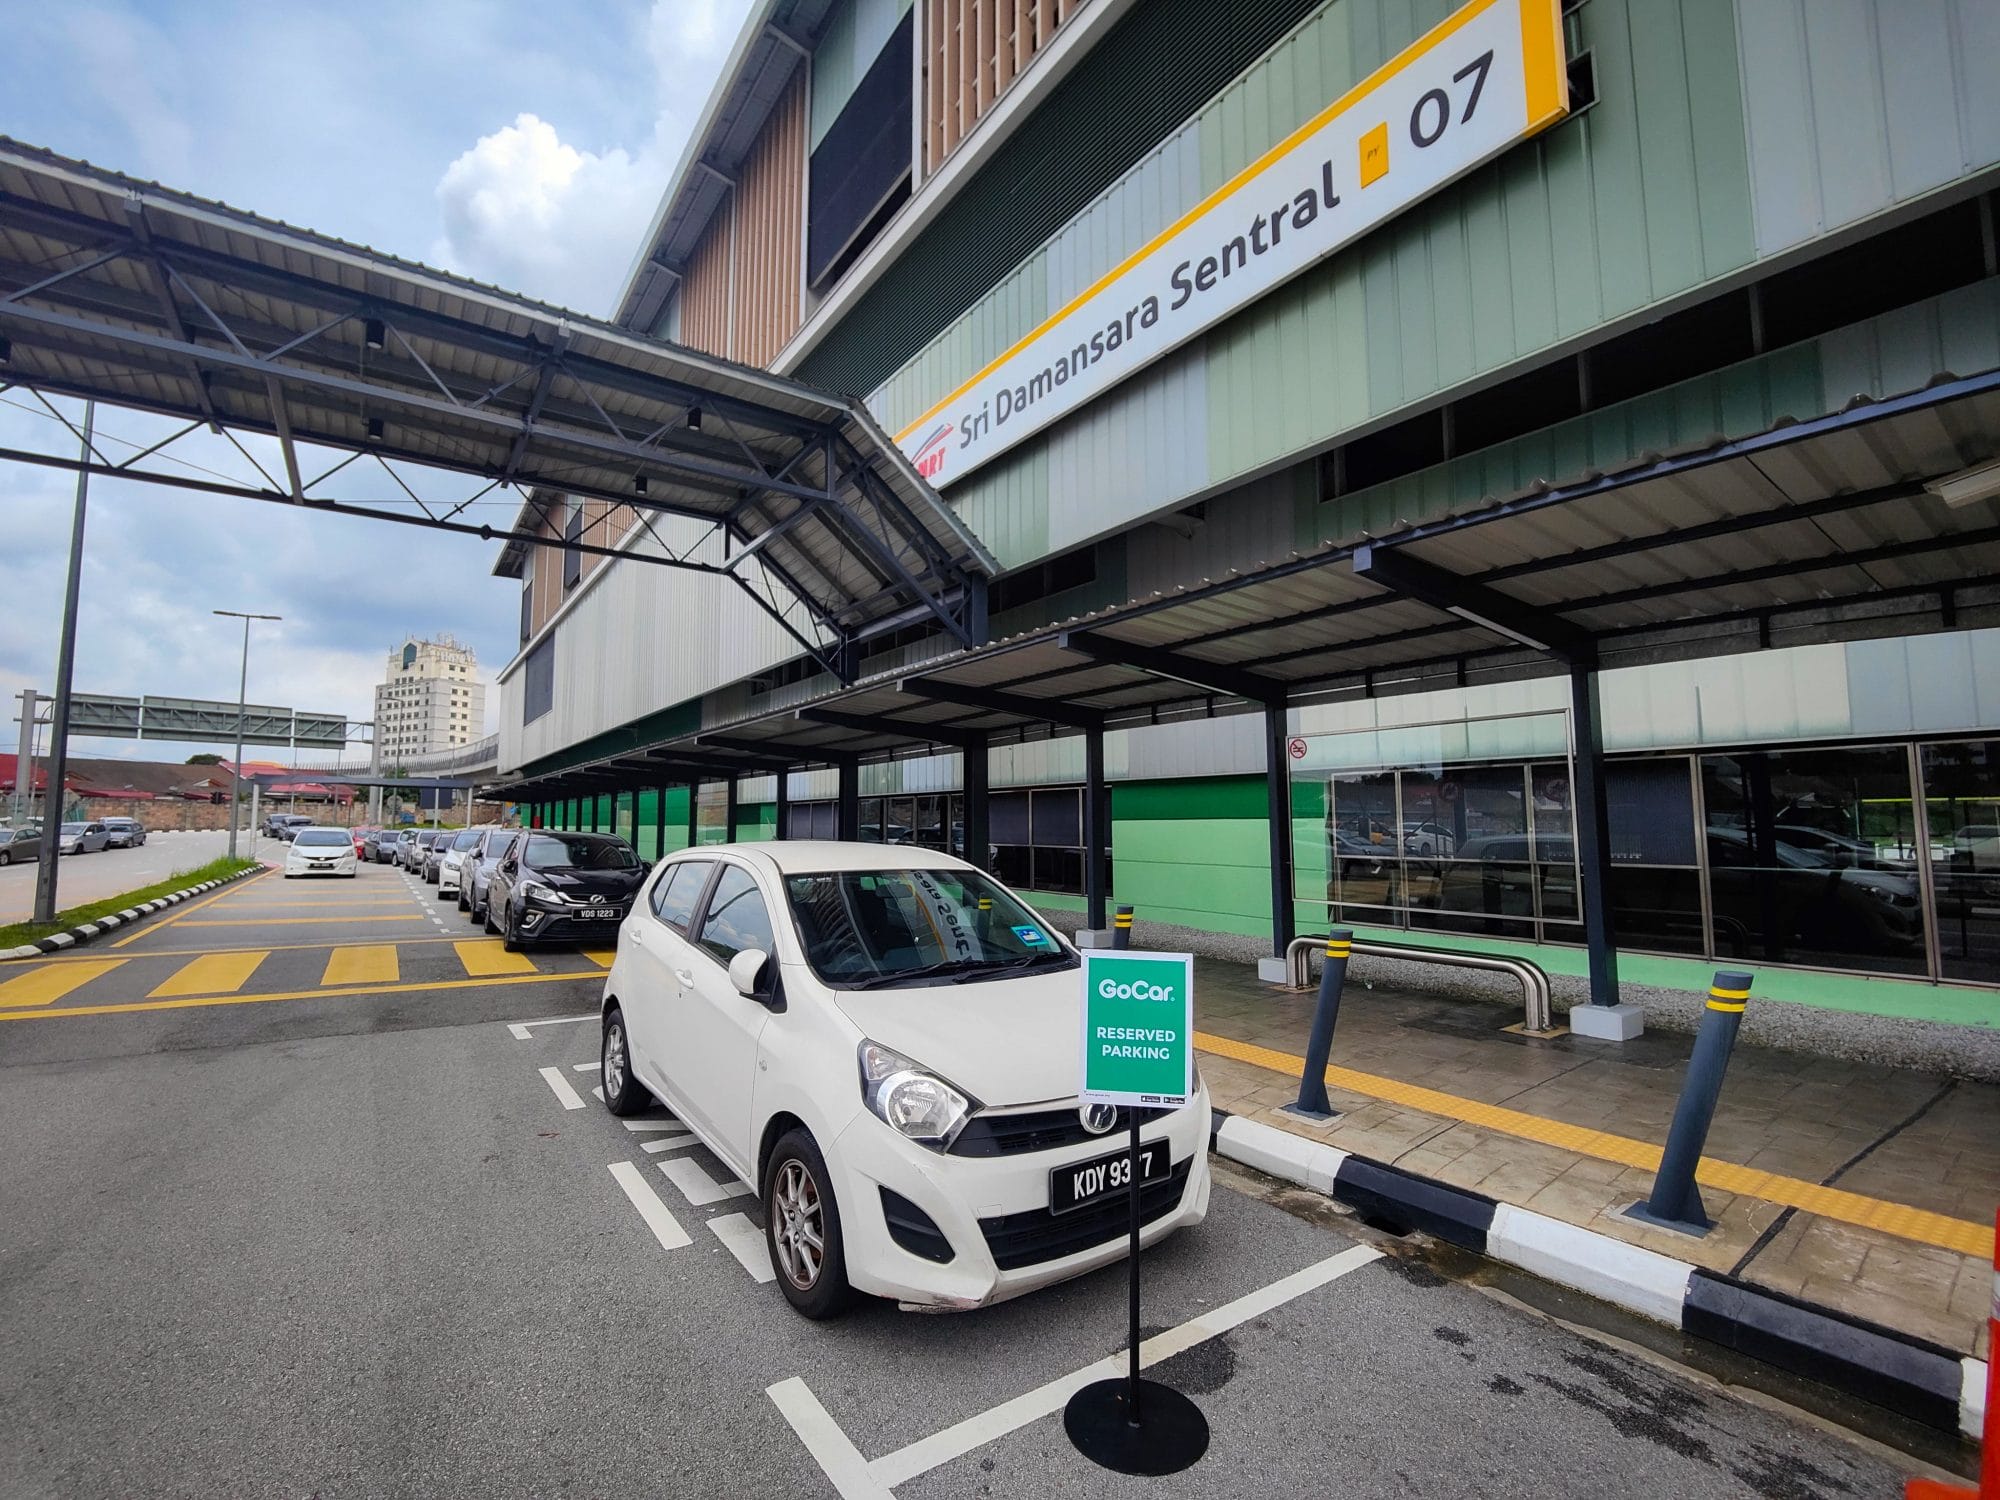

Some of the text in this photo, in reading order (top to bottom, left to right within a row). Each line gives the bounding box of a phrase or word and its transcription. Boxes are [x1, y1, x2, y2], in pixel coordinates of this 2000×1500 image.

[960, 401, 989, 449] Sri
[996, 295, 1159, 426] Damansara
[1171, 160, 1341, 311] Sentral
[1409, 49, 1494, 148] 07
[580, 909, 614, 918] VDS 1223
[1096, 1026, 1176, 1042] RESERVED
[1102, 1044, 1170, 1060] PARKING
[1073, 1152, 1153, 1200] KDY 937
